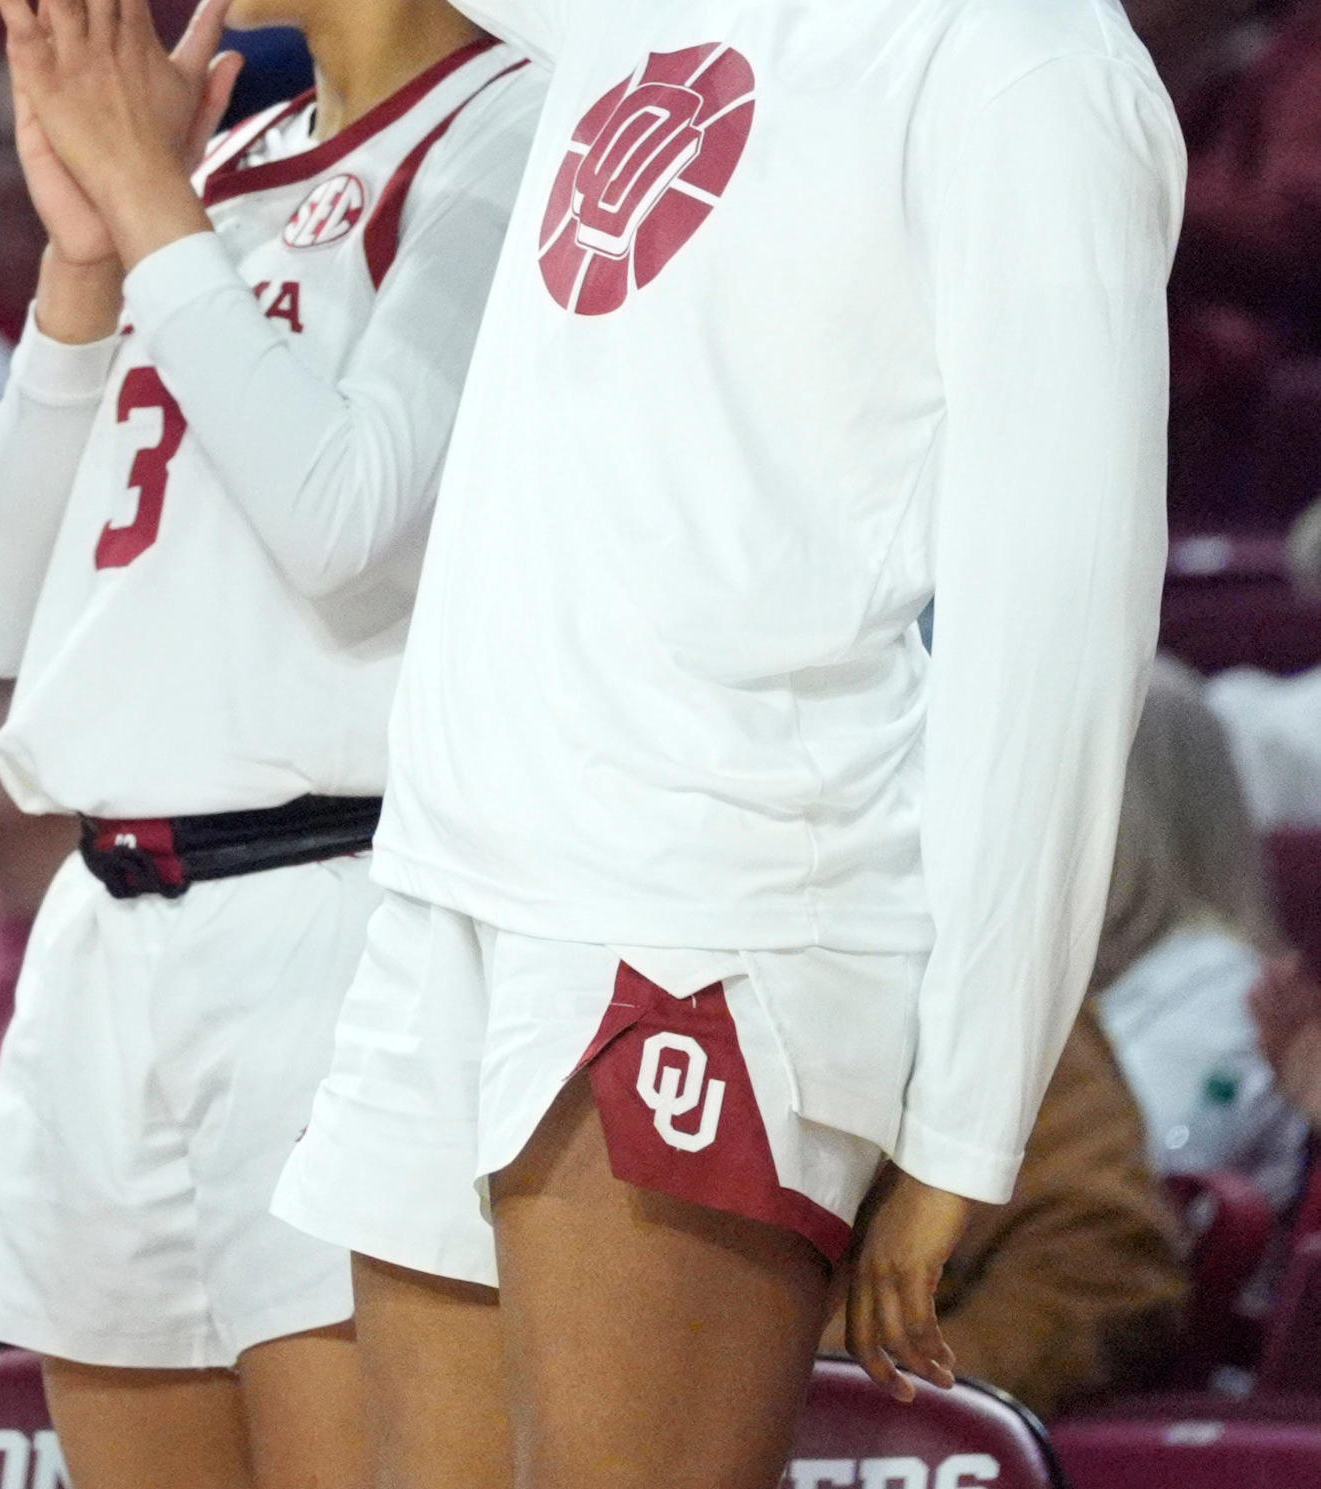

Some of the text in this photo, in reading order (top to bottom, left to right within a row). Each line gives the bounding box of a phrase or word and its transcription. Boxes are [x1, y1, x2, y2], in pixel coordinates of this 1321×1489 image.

[284, 174, 364, 248] SEC
[94, 365, 188, 571] 3
[635, 1031, 726, 1154] OU
